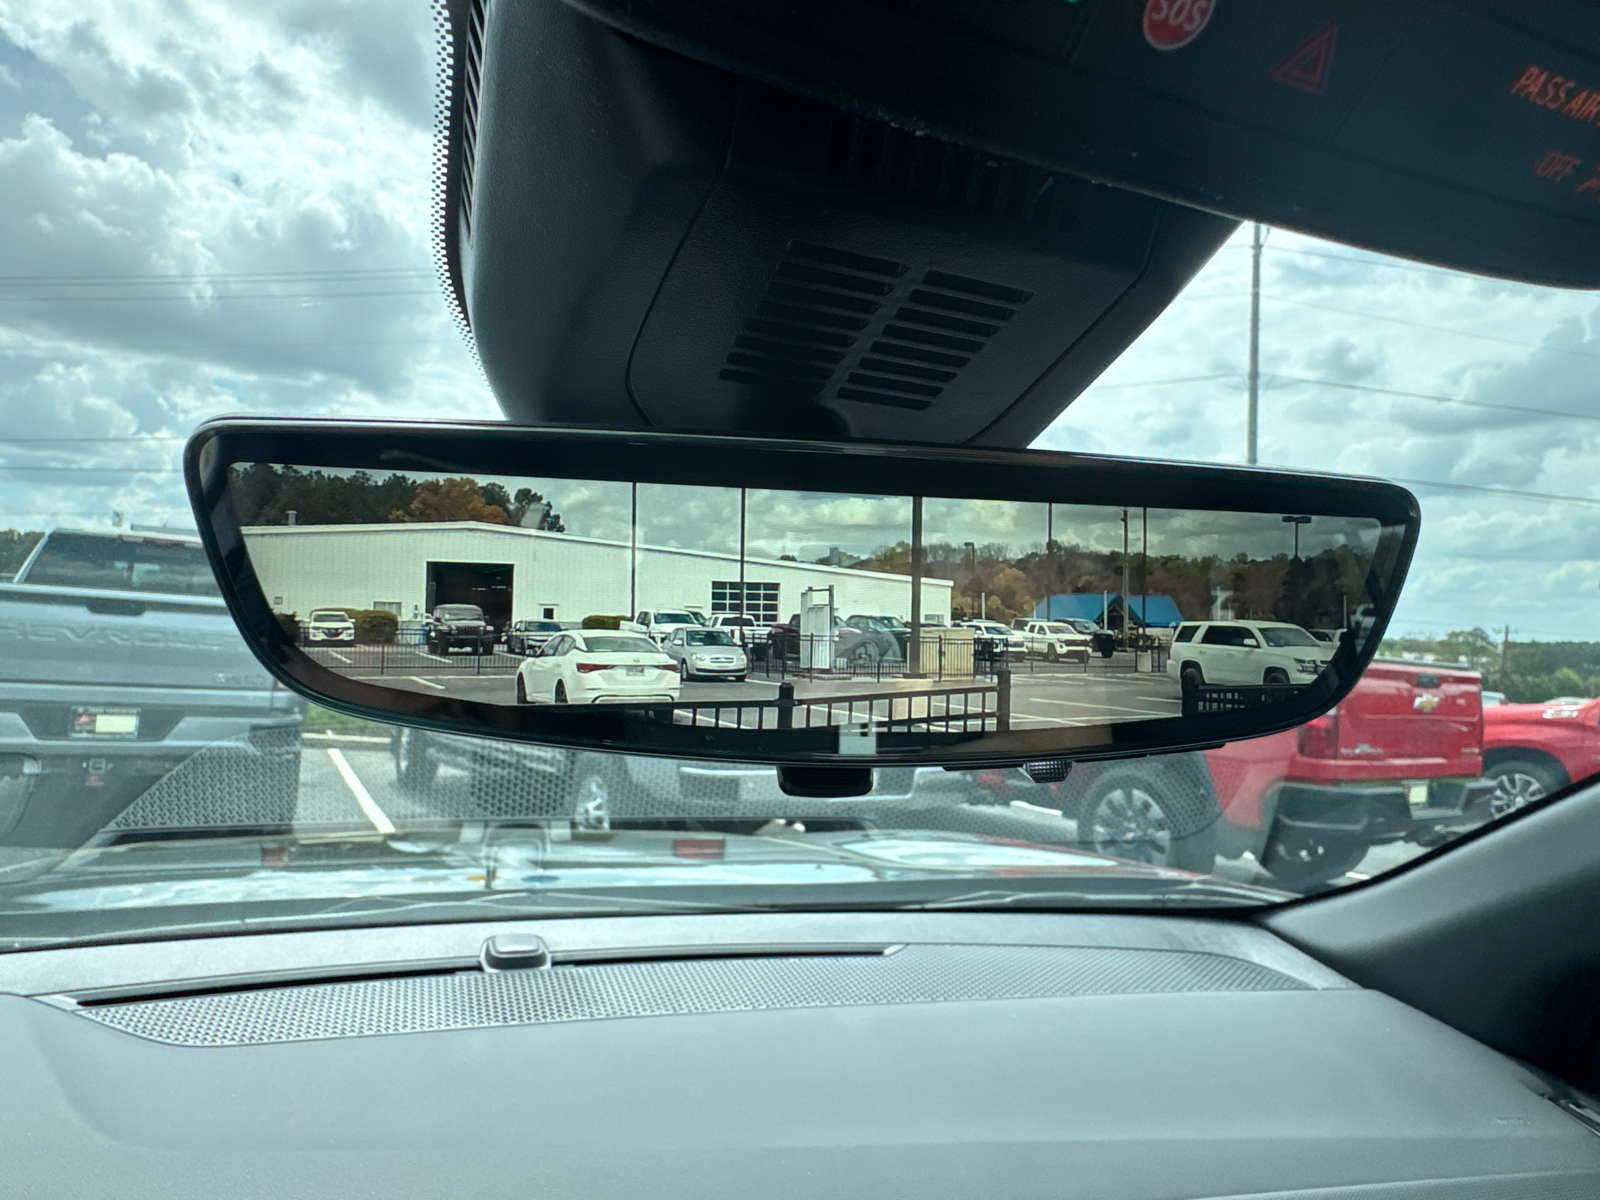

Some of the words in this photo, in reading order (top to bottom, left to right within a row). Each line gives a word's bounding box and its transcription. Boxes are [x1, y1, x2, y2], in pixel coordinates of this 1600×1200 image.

[1151, 0, 1210, 31] SOS
[1510, 65, 1576, 109] PASS
[1533, 149, 1581, 181] OFF
